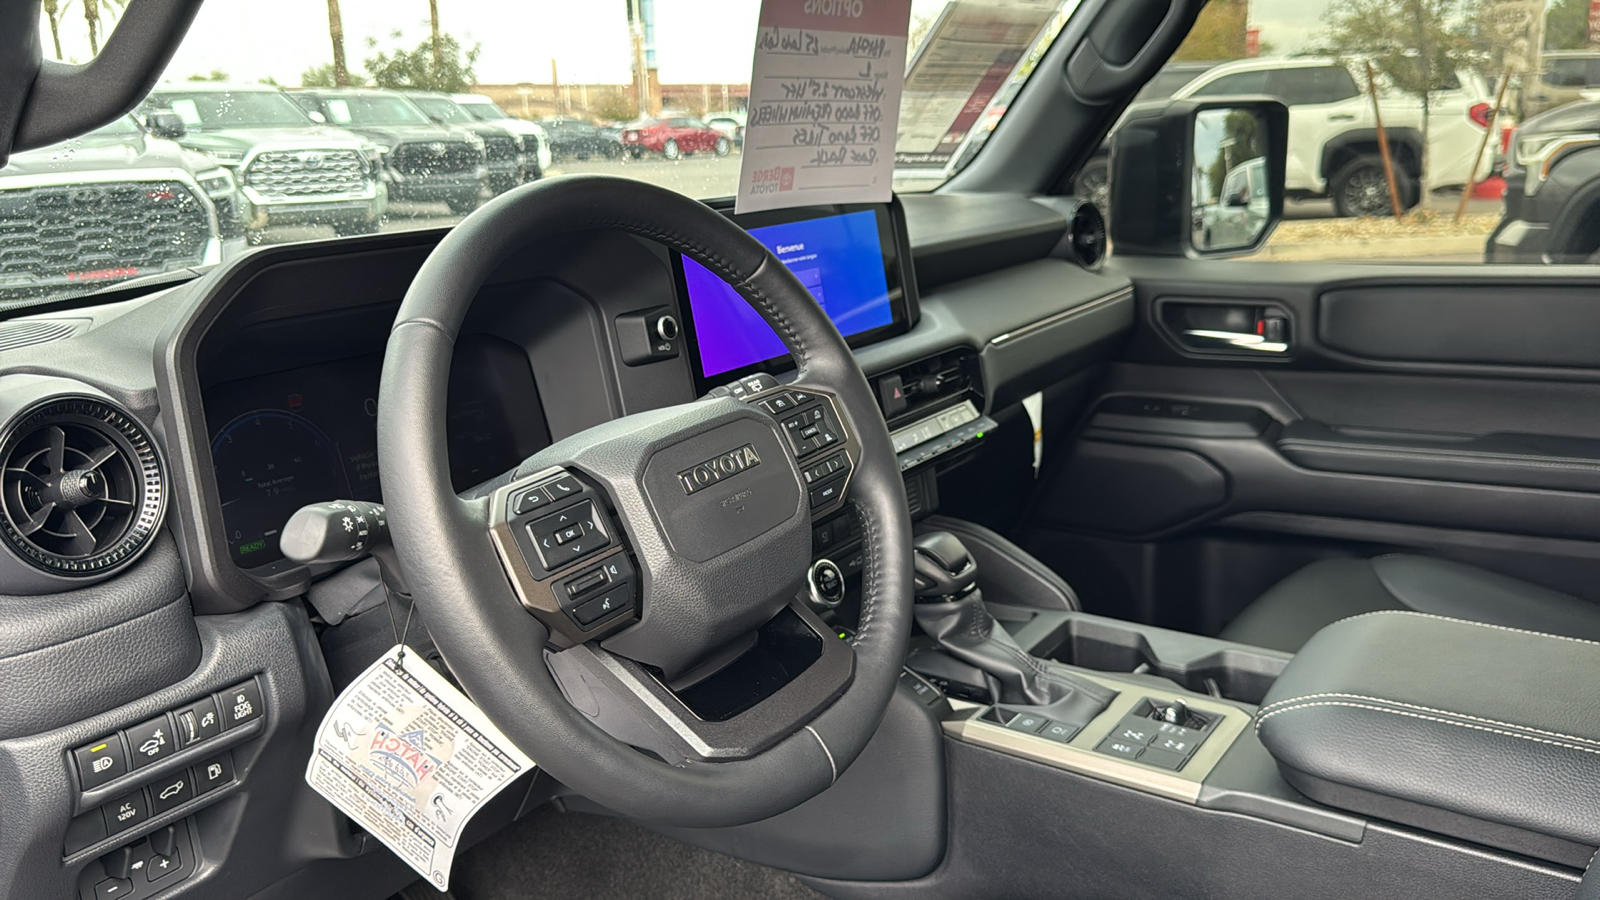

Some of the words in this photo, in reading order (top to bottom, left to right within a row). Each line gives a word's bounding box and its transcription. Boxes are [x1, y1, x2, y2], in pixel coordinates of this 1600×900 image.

[677, 447, 759, 491] TOYOTA
[272, 475, 294, 486] Average
[565, 529, 575, 538] OK
[242, 541, 264, 553] READY
[234, 702, 250, 713] FOG
[234, 706, 253, 720] LIGHT
[148, 747, 160, 756] OFF
[119, 803, 132, 813] AC
[117, 809, 136, 822] 120V
